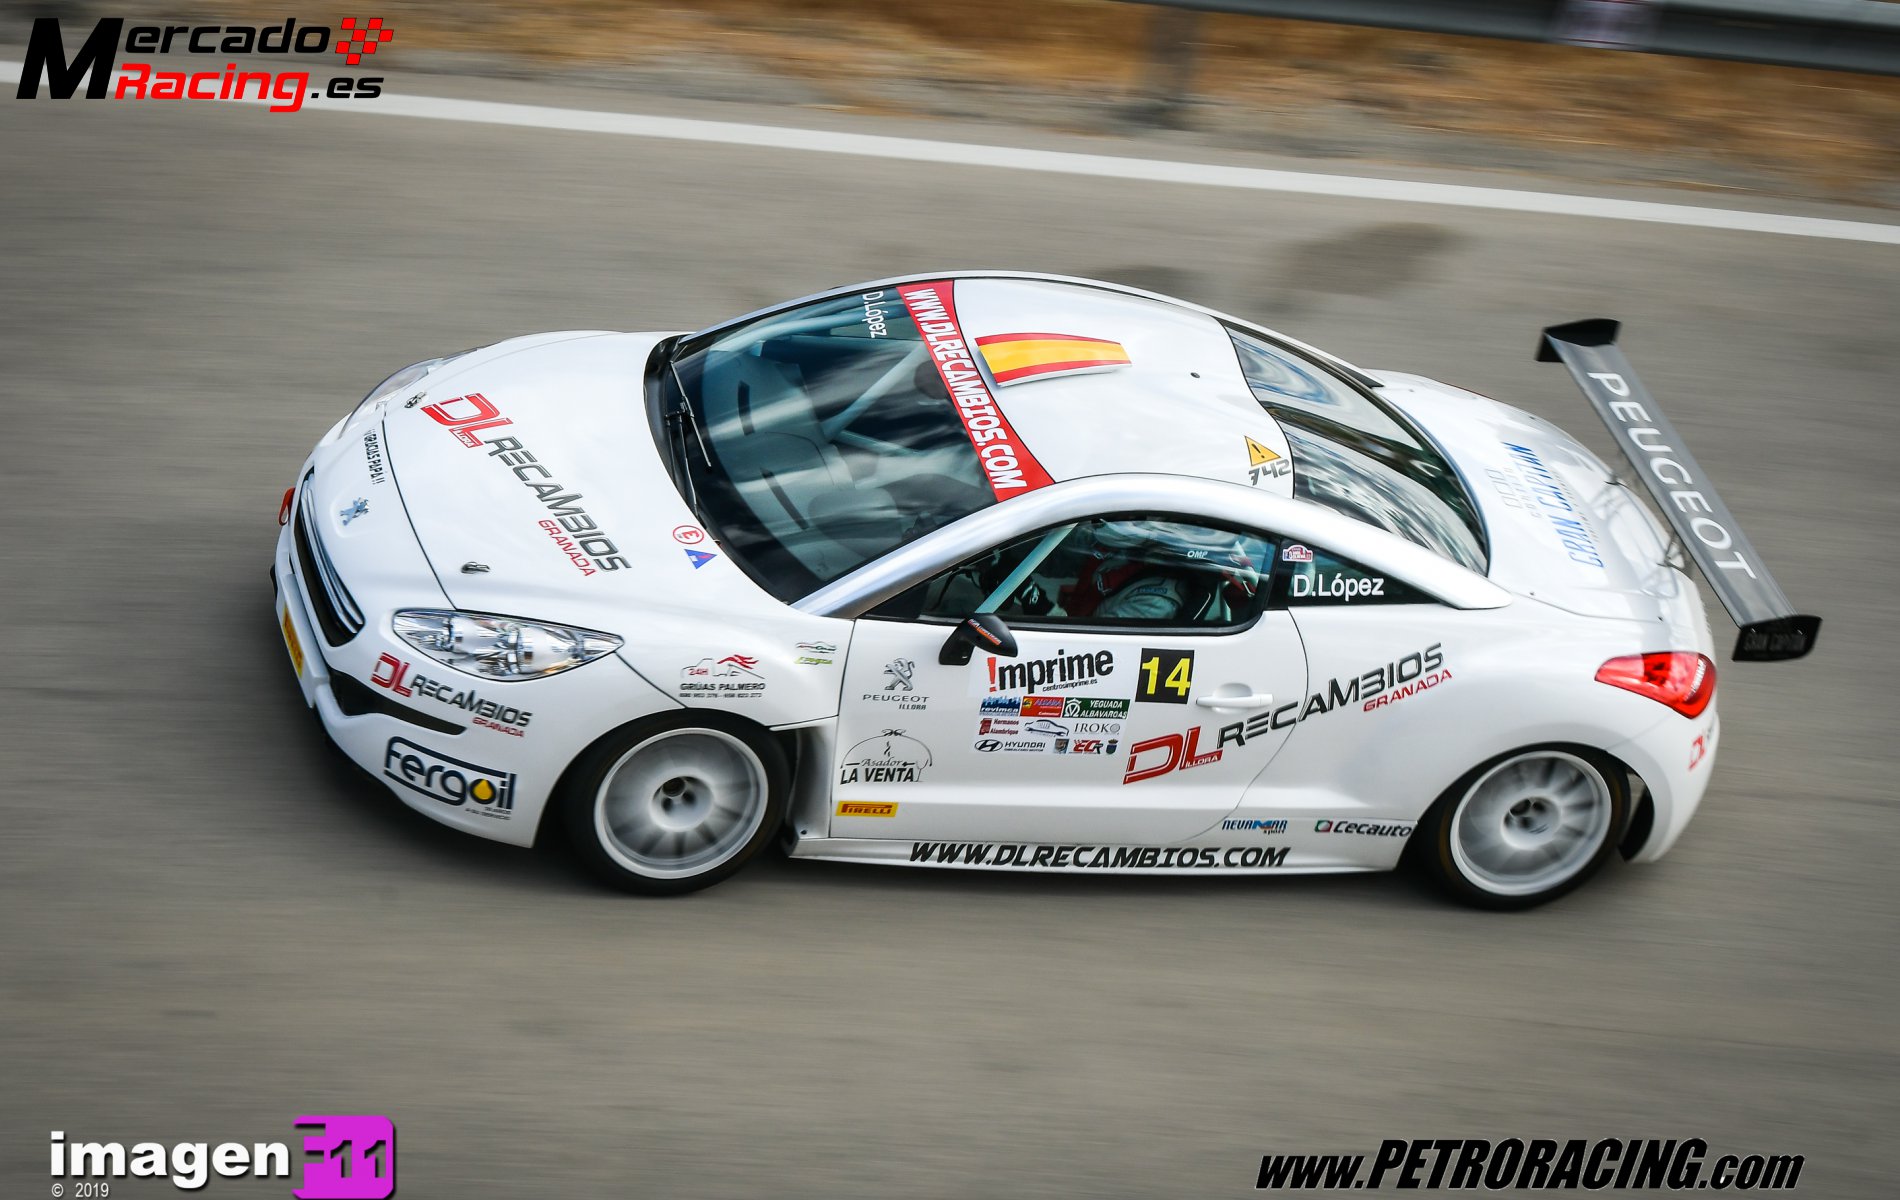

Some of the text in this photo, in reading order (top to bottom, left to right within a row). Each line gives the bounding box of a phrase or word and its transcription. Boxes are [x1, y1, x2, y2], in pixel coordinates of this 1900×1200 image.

[862, 290, 888, 339] D.López
[903, 287, 1028, 490] WWW.DLRECAMBIOS.COM
[1248, 459, 1292, 486] 742
[1587, 371, 1757, 580] PEUGEOT
[484, 435, 632, 573] RECAMBIOS
[538, 519, 597, 578] GRANADA
[1187, 550, 1208, 559] OMP
[1293, 573, 1385, 602] D.López
[1142, 656, 1192, 697] 14
[1363, 668, 1453, 712] GRANADA
[410, 673, 533, 728] RECAMBIOS
[862, 694, 930, 702] PEUGEOT
[1090, 700, 1123, 709] YEGUADA
[472, 716, 526, 738] GRANADA
[1123, 642, 1445, 785] DL RECAMBIOS
[1004, 741, 1047, 749] HYUNDAI
[861, 756, 903, 767] Asador
[840, 767, 914, 785] LA VENTA
[841, 803, 893, 815] PIRELLI
[909, 841, 1291, 869] WWW.DLRECAMBIOS.COM
